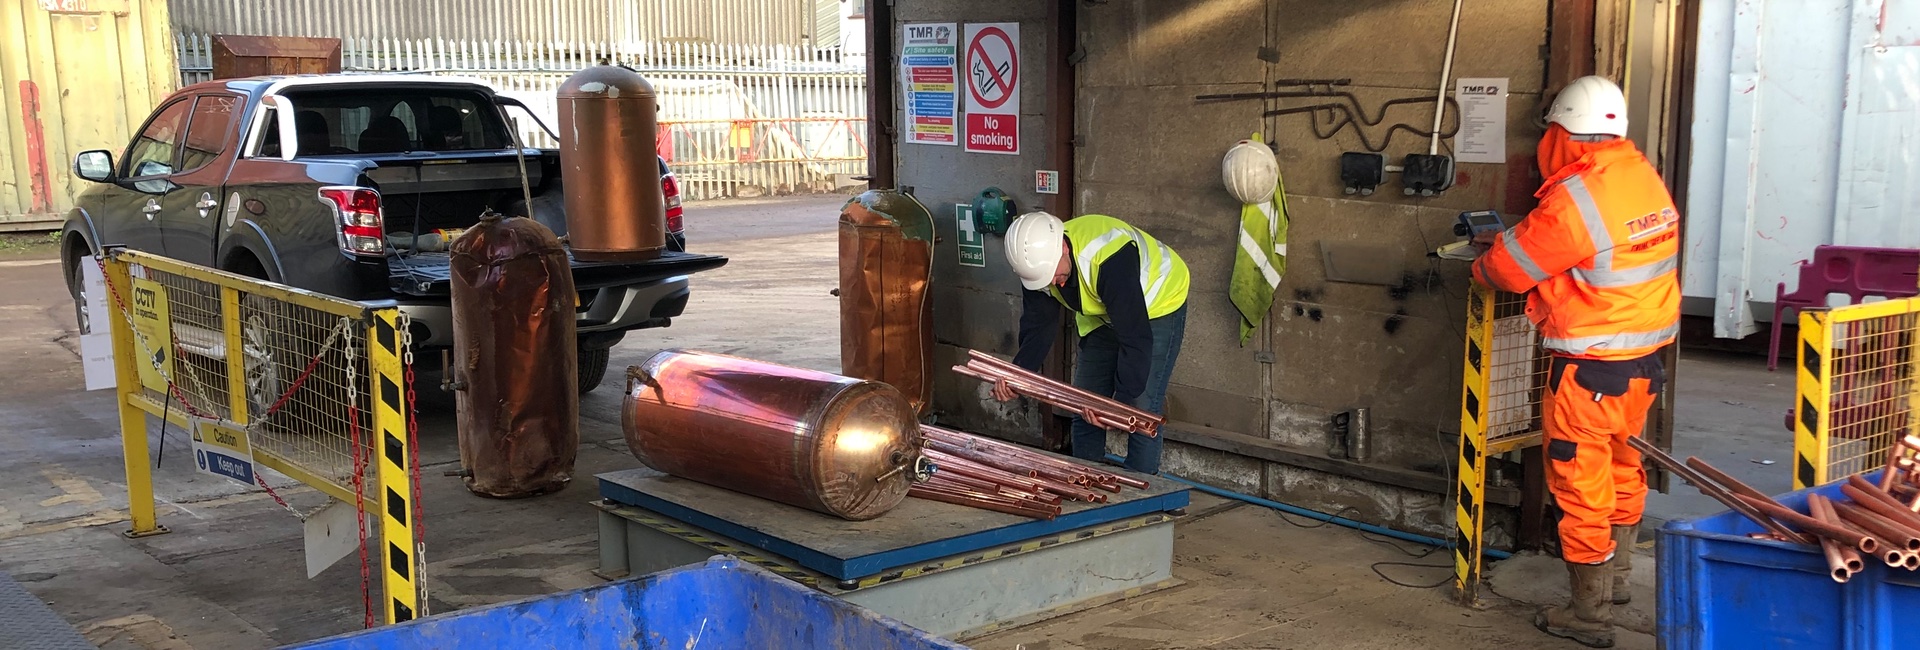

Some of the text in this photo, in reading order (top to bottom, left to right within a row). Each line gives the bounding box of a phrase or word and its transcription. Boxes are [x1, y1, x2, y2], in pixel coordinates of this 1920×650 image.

[909, 26, 933, 38] TMR
[927, 46, 948, 54] safety
[984, 116, 999, 130] No
[970, 132, 1013, 150] smoking
[1626, 213, 1660, 234] TMR
[960, 251, 982, 260] First aid
[135, 287, 156, 309] CCTV
[213, 428, 238, 448] Caution
[216, 455, 246, 477] Keep out
